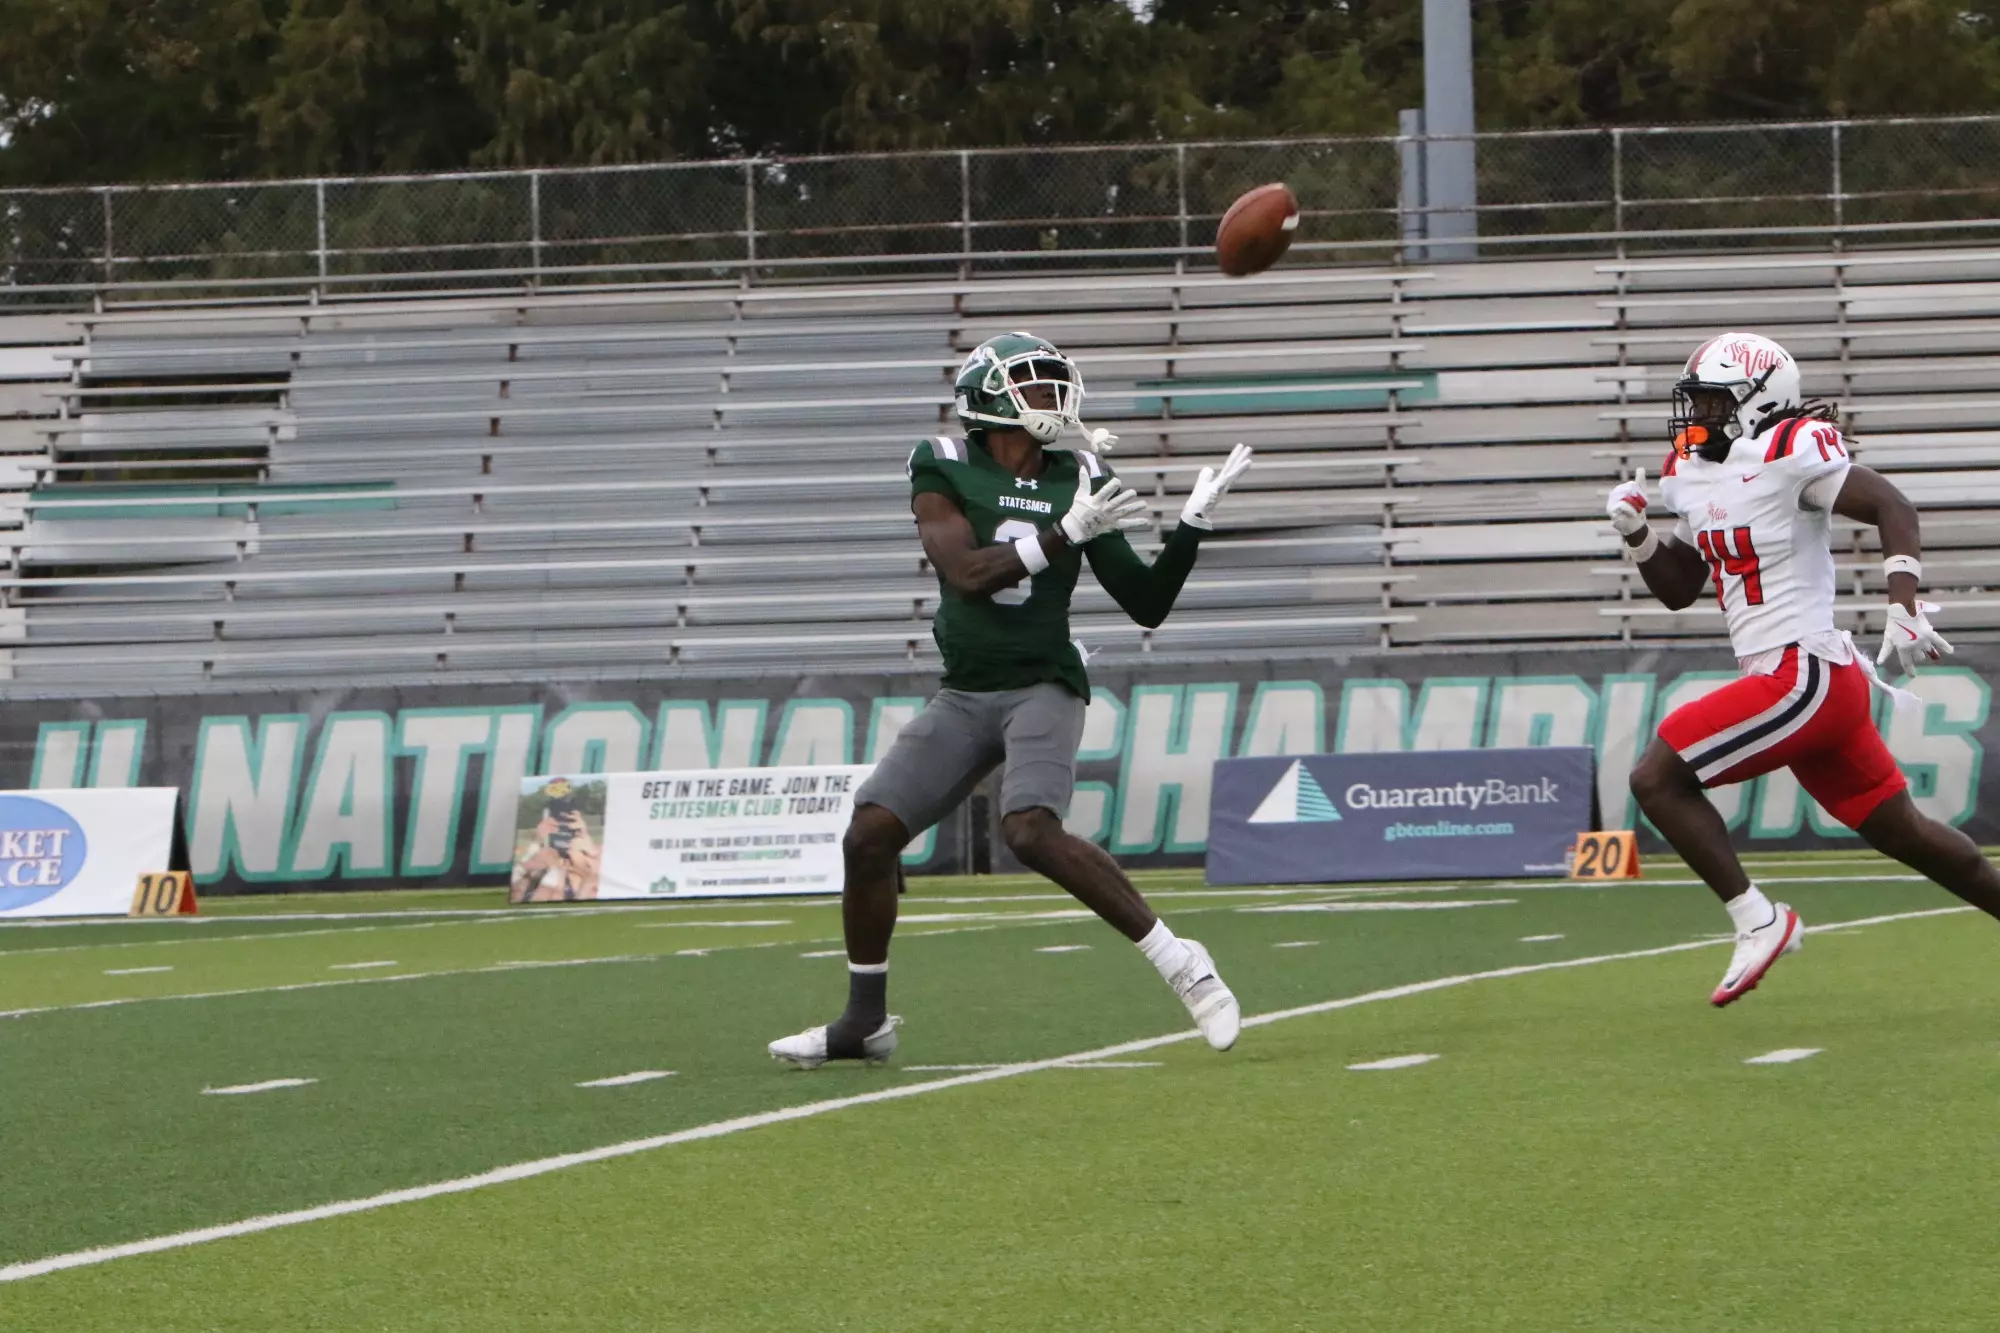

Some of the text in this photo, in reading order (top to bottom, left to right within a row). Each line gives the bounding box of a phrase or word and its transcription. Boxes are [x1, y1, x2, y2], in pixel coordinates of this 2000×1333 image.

[1737, 347, 1785, 378] Ville
[1811, 427, 1845, 462] 14
[999, 496, 1052, 514] STATESMEN
[1697, 526, 1764, 611] 14
[642, 775, 852, 799] GET IN THE GAME. JOIN THE
[1345, 777, 1560, 810] GuarantyBank
[649, 796, 842, 819] STATESMEN CLUB TODAY!
[0, 829, 70, 859] KET
[1384, 820, 1515, 841] gbtonline.com
[1577, 835, 1622, 876] 20
[0, 858, 63, 887] CE
[139, 875, 178, 914] 10
